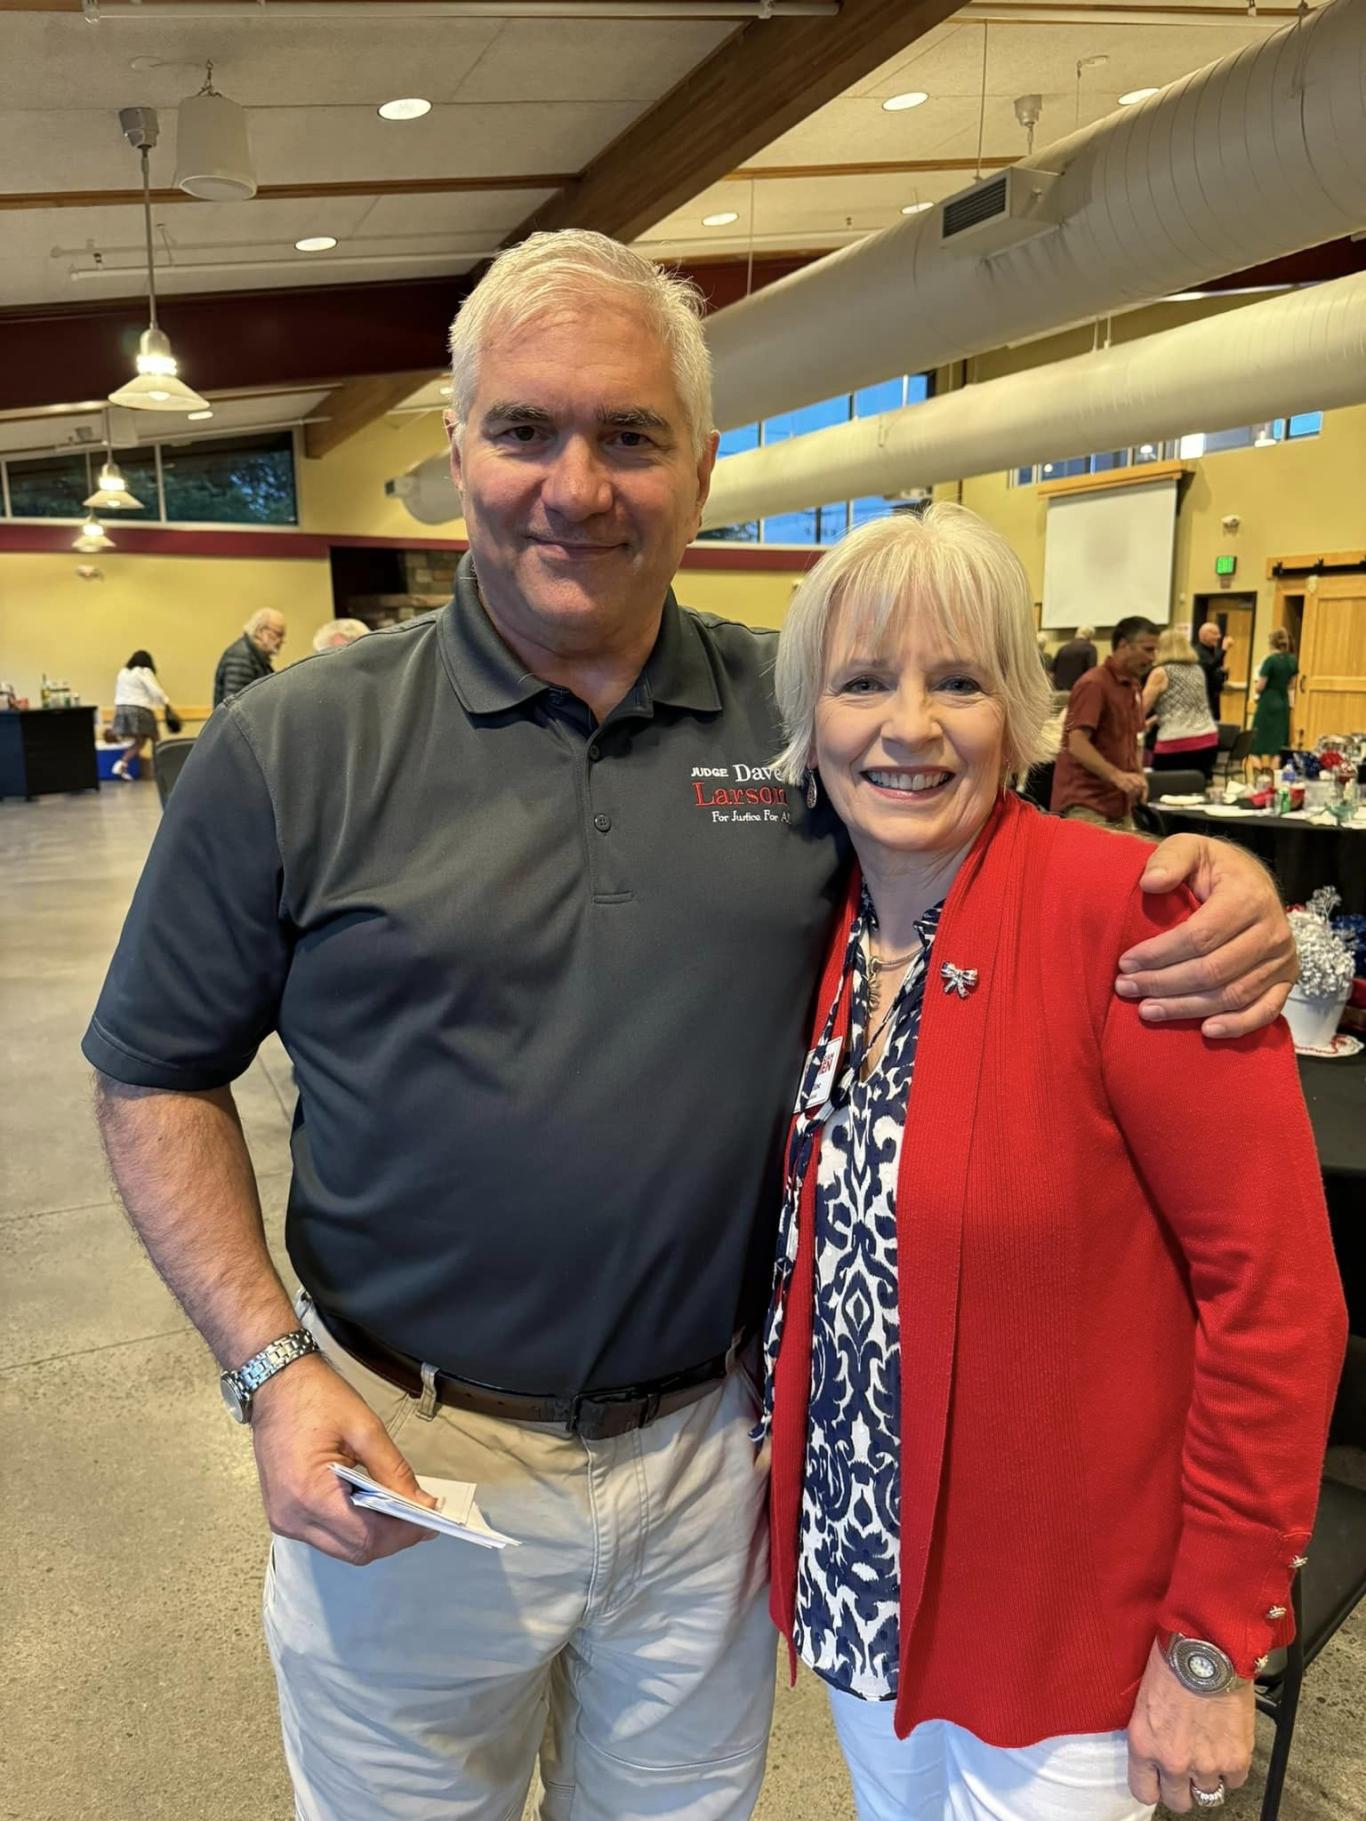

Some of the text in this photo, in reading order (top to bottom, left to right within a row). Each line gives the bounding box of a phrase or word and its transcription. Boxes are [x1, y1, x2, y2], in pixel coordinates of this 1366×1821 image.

[690, 763, 785, 782] JUDGE Dave
[692, 781, 788, 807] Larson
[712, 811, 729, 822] For
[731, 810, 761, 822] Justice
[763, 809, 778, 821] For
